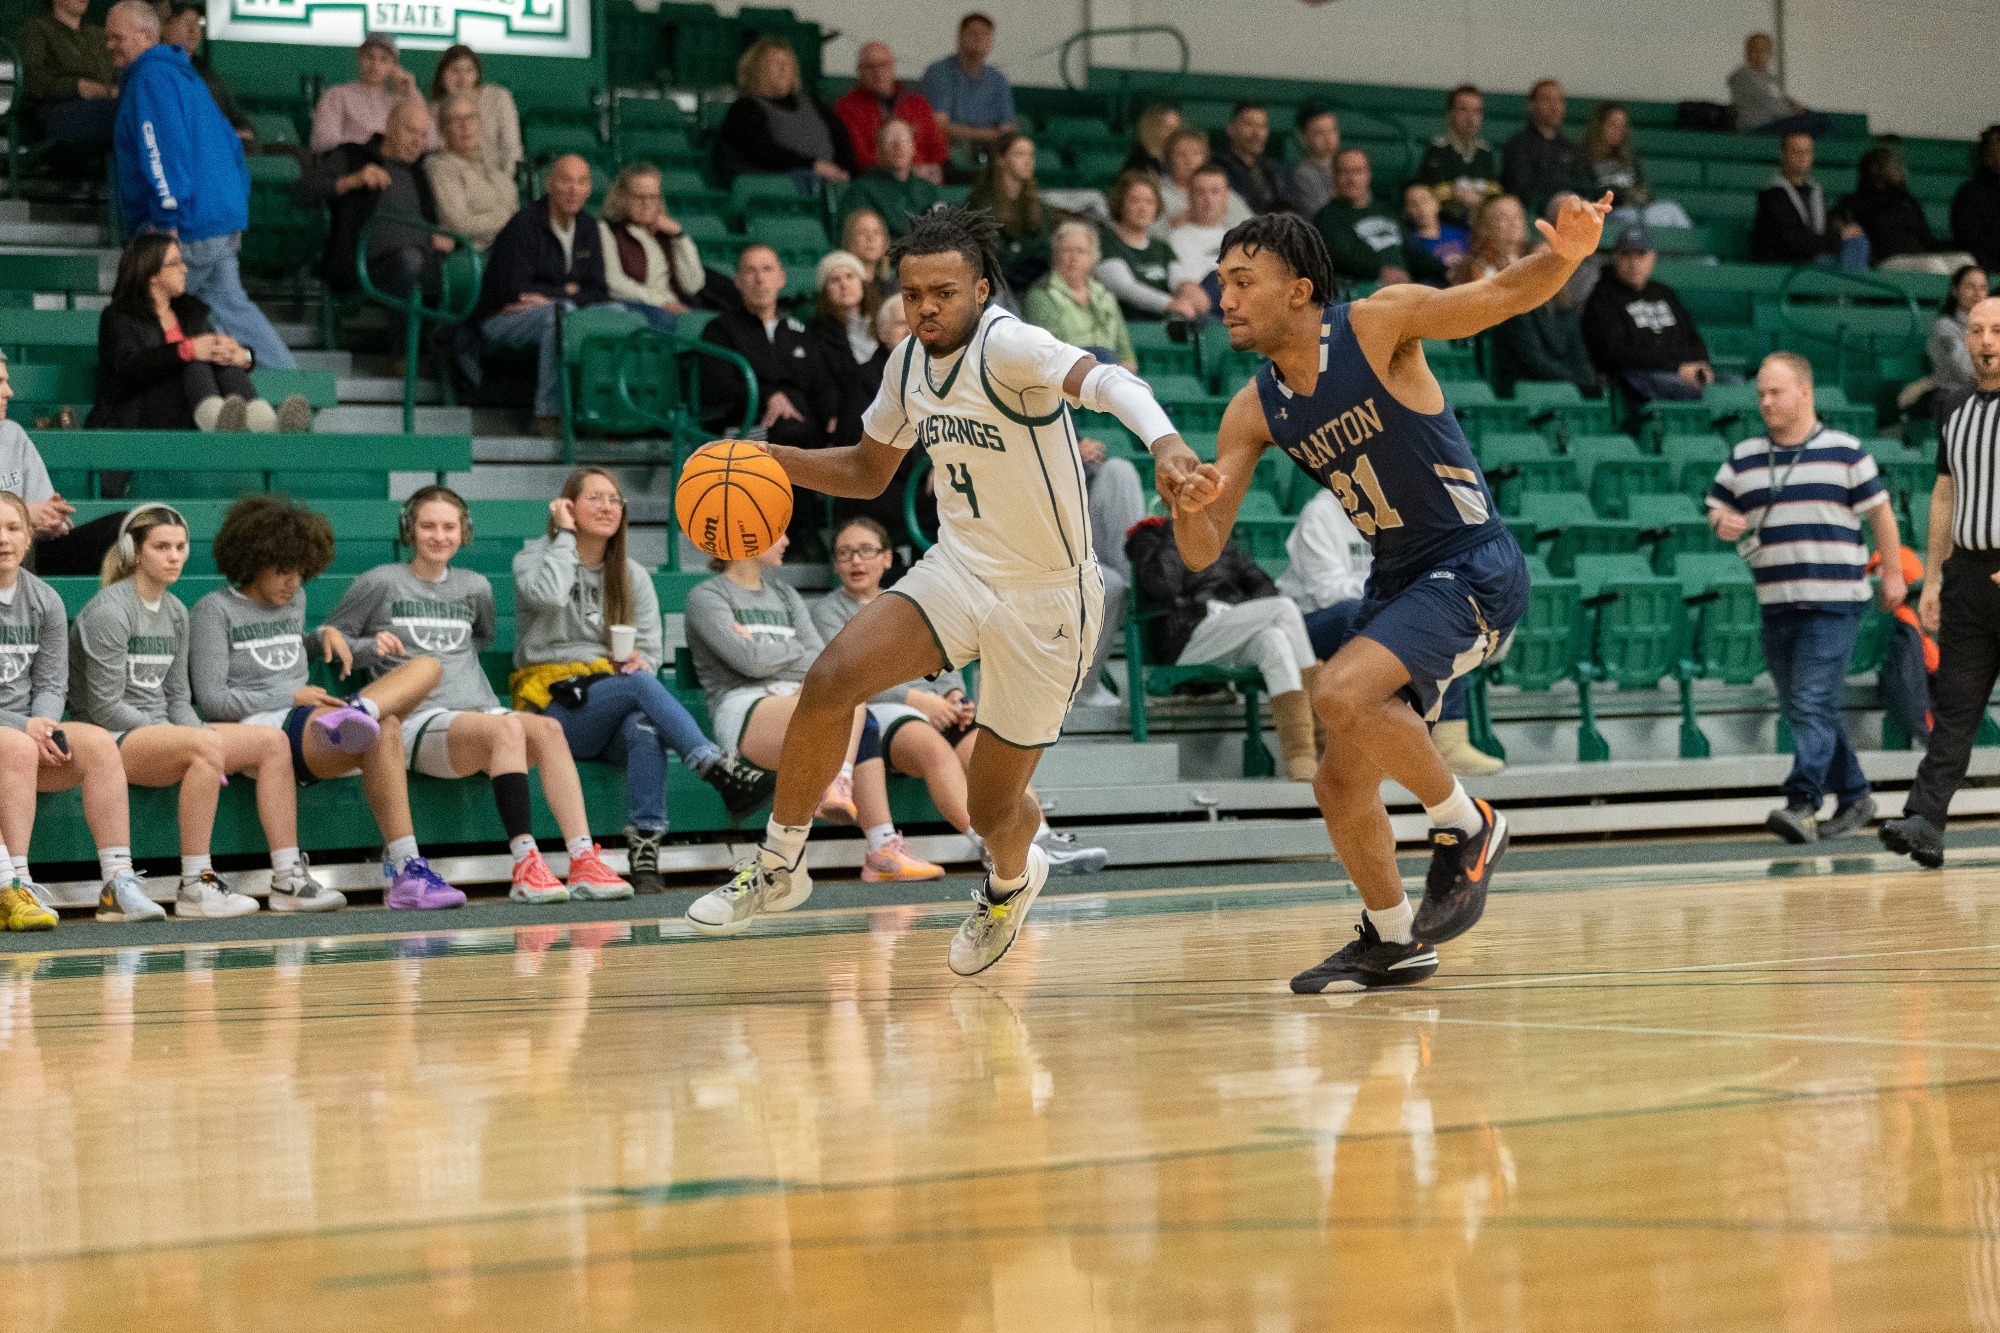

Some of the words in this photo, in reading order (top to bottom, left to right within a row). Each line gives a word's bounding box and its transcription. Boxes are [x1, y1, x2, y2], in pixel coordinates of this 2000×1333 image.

[376, 3, 445, 27] STATE
[946, 462, 980, 518] 4
[1330, 453, 1404, 535] 21
